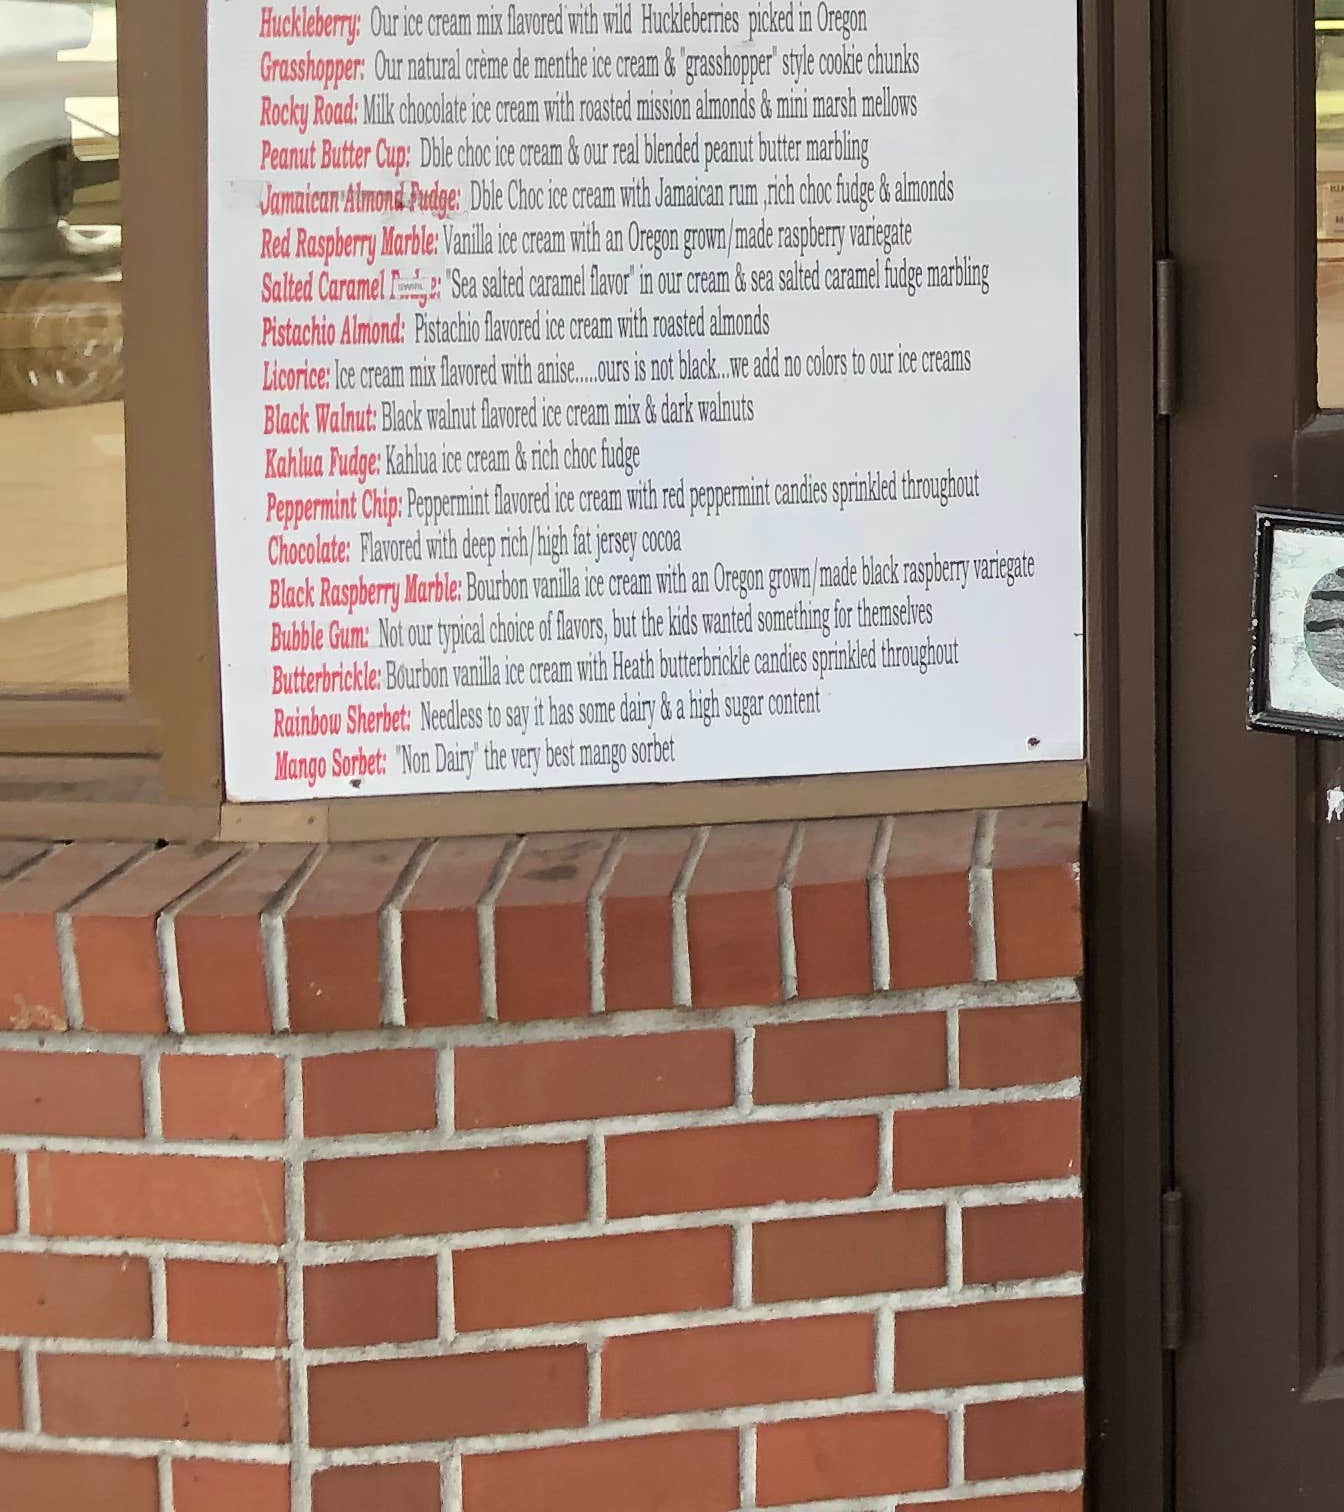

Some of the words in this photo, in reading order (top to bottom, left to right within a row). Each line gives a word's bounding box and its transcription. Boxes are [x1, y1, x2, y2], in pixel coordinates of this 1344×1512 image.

[258, 4, 362, 47] Huckleberry:
[369, 4, 400, 38] Our
[402, 4, 424, 37] ice
[426, 12, 473, 37] cream
[475, 3, 504, 37] mix
[506, 2, 565, 37] flavored
[563, 1, 600, 36] with
[601, 1, 633, 35] wild
[640, 0, 740, 35] Huckleberries
[747, 0, 796, 43] picked
[797, 0, 814, 33] in
[816, 0, 869, 42] Oregon
[260, 313, 337, 348] Pistachio
[338, 311, 406, 346] Almond:
[413, 309, 481, 344] Pistachio
[483, 308, 542, 343] flavored
[544, 308, 566, 342] ice
[568, 316, 614, 341] cream
[616, 305, 650, 340] with
[651, 304, 706, 339] roasted
[708, 302, 771, 338] almonds
[267, 527, 352, 567] Chocolate:
[359, 524, 423, 563] Flavored
[424, 522, 459, 561] with
[461, 527, 497, 567] deep
[499, 523, 570, 565] rich/high
[572, 523, 593, 556] fat
[595, 522, 639, 563] jersey
[641, 528, 683, 554] cocoa
[273, 749, 328, 789] Mango
[331, 744, 388, 778] Sorbet:
[395, 743, 432, 775] "Non
[433, 740, 480, 781] Dairy"
[483, 739, 508, 772] the
[510, 746, 542, 778] very
[543, 736, 577, 769] best
[578, 742, 628, 775] mango
[630, 733, 677, 765] sorbet
